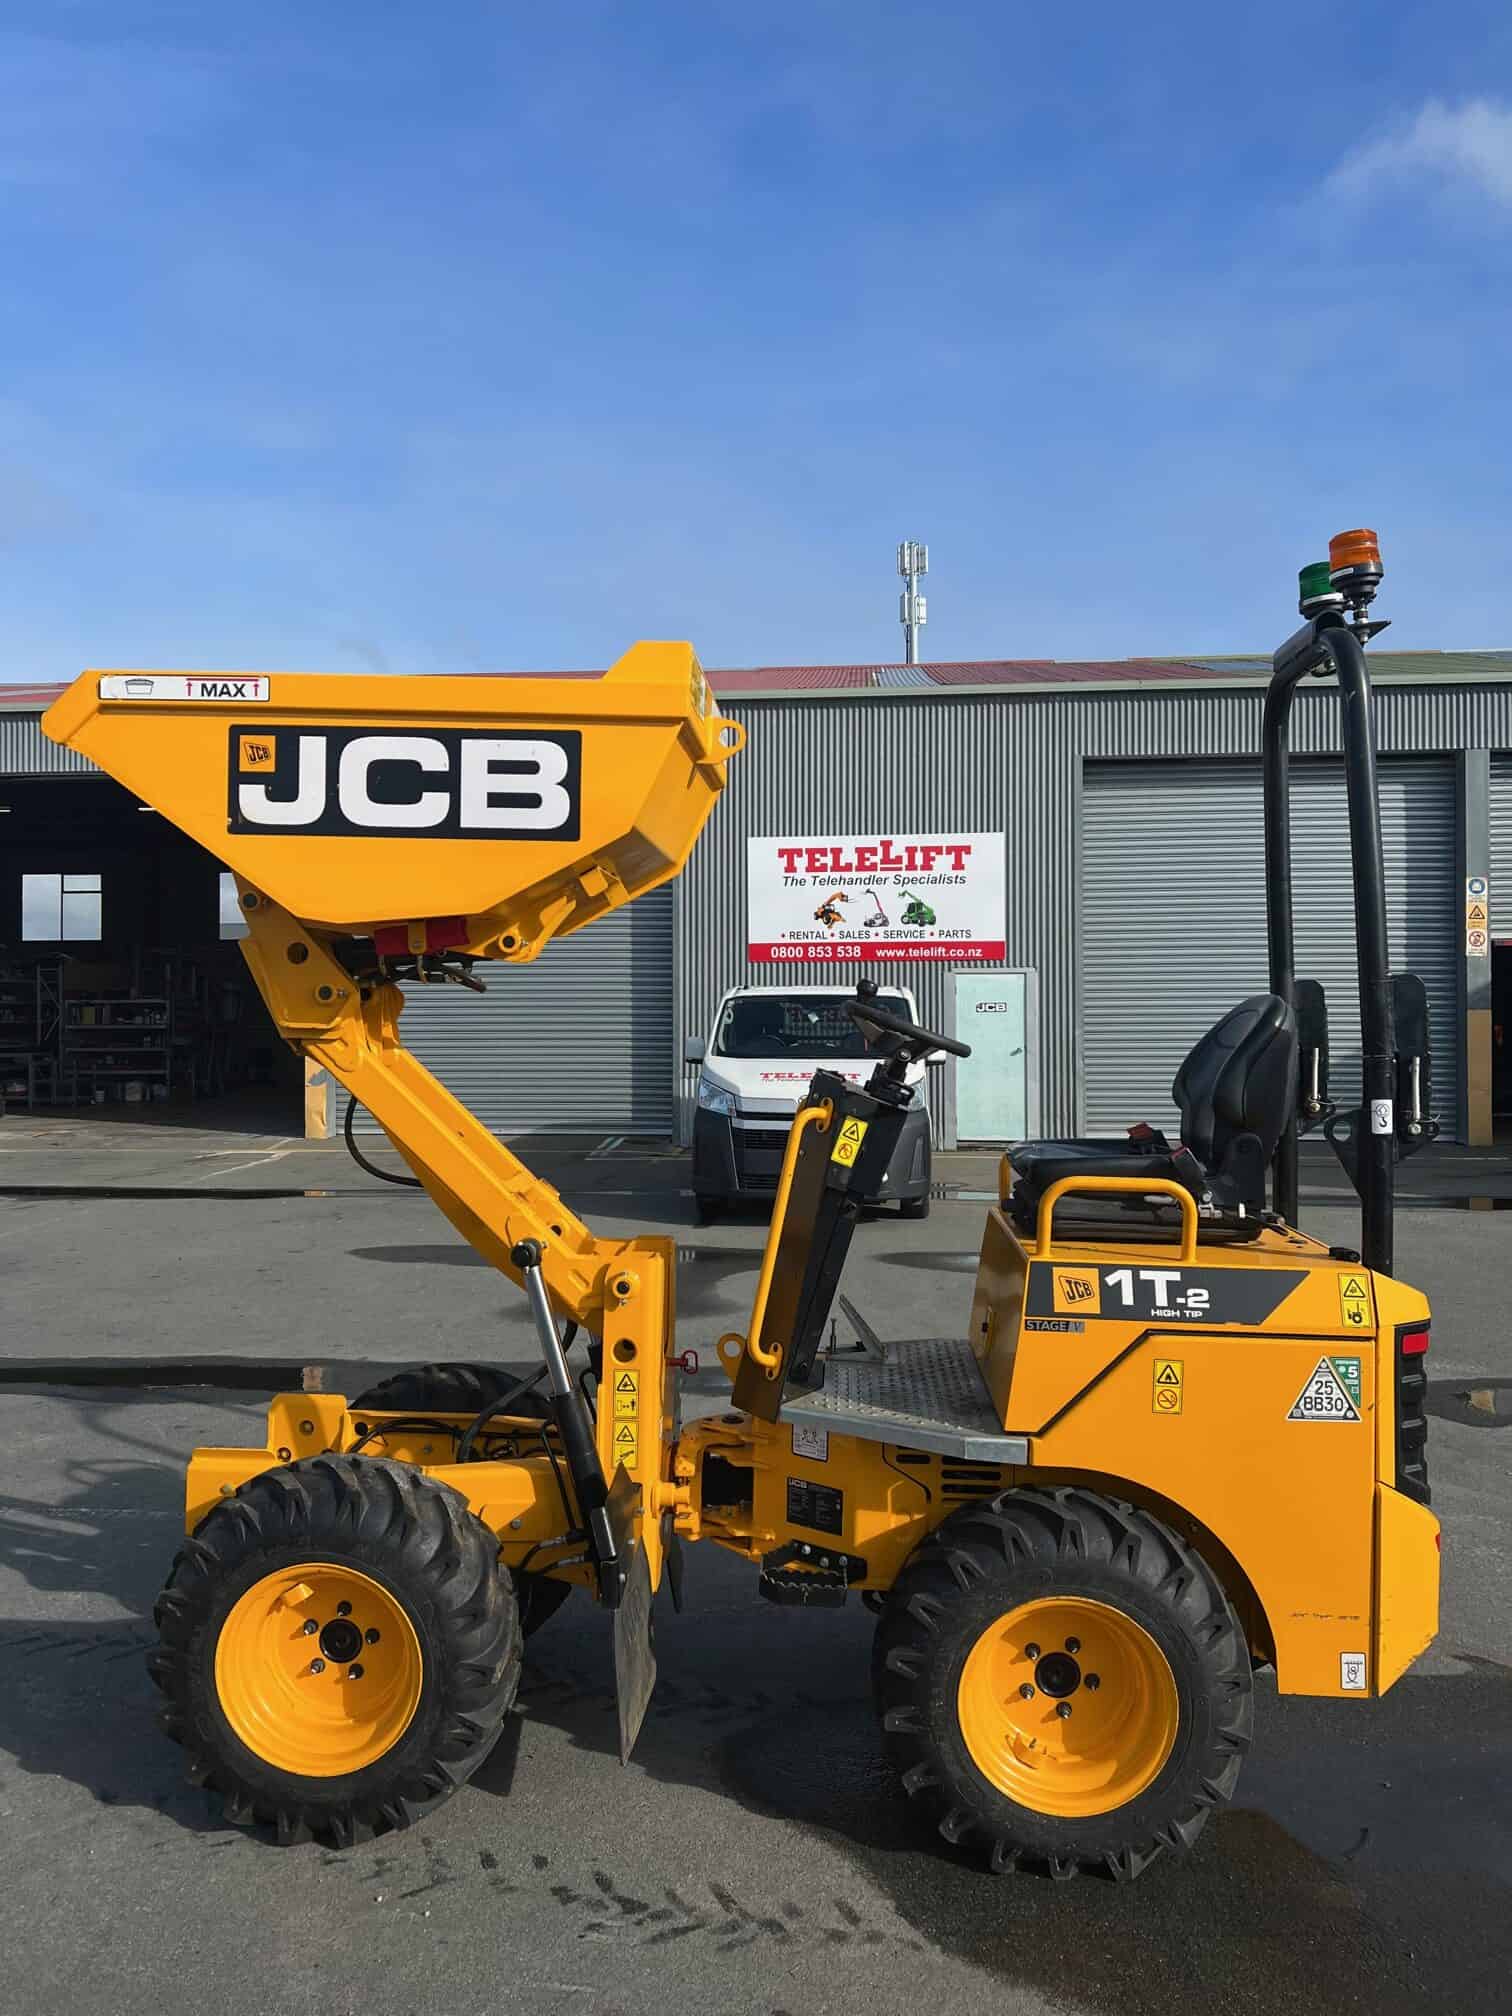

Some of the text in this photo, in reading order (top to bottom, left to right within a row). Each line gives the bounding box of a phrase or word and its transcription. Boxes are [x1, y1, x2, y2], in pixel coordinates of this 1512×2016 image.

[201, 683, 247, 697] MAX
[248, 744, 270, 762] JCB
[239, 736, 570, 829] JCB
[778, 840, 972, 873] TELELIFT
[783, 873, 967, 887] The Telehandler Specialists
[789, 929, 972, 940] RENTAL SALES SERVICE PARTS
[771, 946, 983, 957] 0800 853 538 www.telelift.co.nz
[976, 1002, 1006, 1012] JCB
[1065, 1279, 1092, 1302] JCB
[1105, 1270, 1210, 1308] 1T-2
[1151, 1309, 1203, 1318] HIGH TIP
[1026, 1320, 1068, 1331] STAGE
[1315, 1380, 1334, 1396] 25
